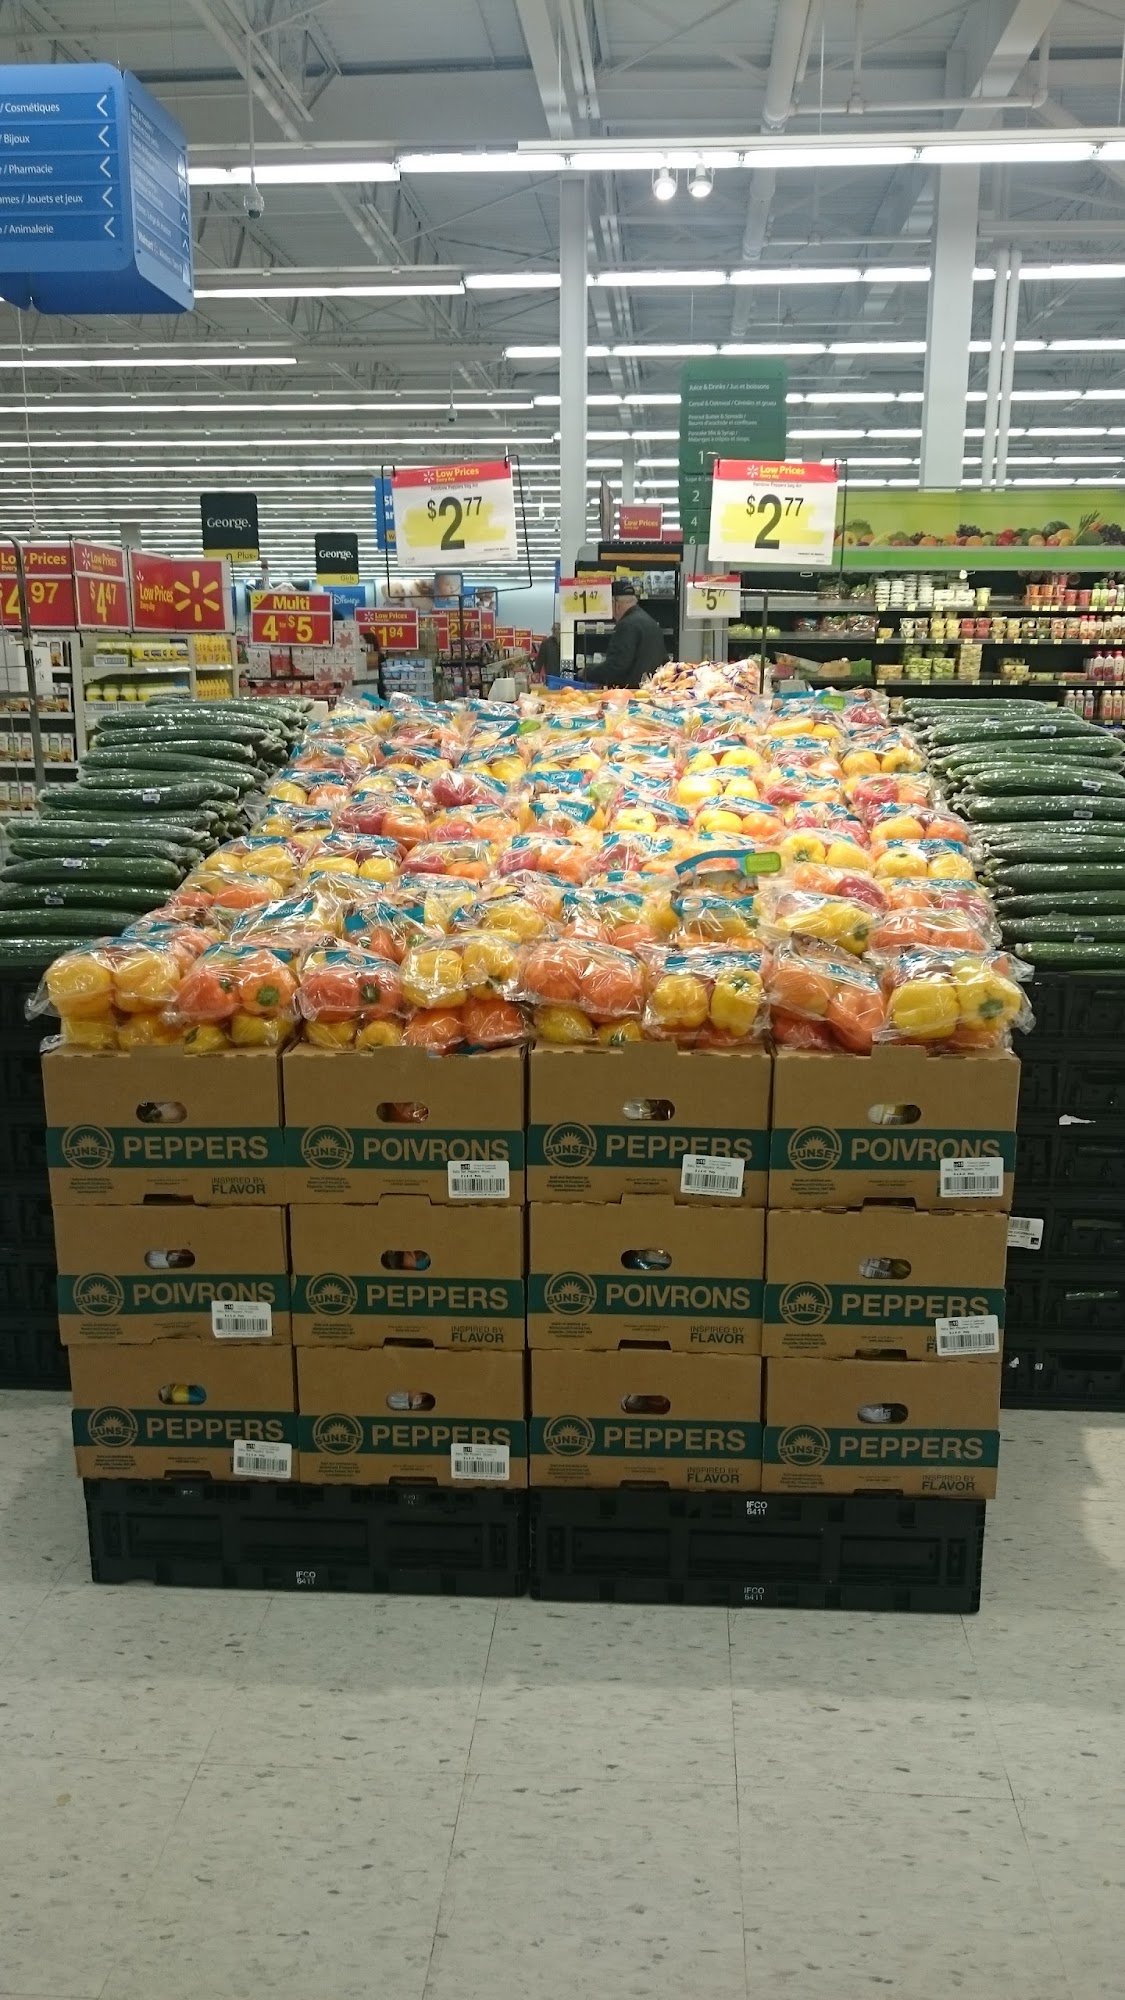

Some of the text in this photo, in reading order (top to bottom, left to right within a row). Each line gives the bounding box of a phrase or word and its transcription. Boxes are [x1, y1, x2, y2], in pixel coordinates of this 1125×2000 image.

[5, 102, 60, 114] Cosmétiques
[4, 133, 31, 146] Bijoux
[9, 164, 53, 174] Pharmacie
[27, 194, 53, 204] Jouets
[55, 195, 63, 203] et
[64, 194, 83, 205] jeux
[9, 224, 54, 234] Animalerie
[698, 450, 704, 465] 1
[436, 467, 480, 477] Low Prices
[760, 465, 805, 475] Low Prices
[692, 490, 700, 502] 2
[691, 516, 697, 526] 4
[689, 536, 695, 545] 6
[29, 553, 67, 565] Prices
[91, 551, 117, 567] Low Prices
[140, 583, 174, 603] Low Prices
[273, 595, 310, 610] Multi
[262, 615, 278, 641] 4
[65, 1146, 114, 1160] SUNSET
[122, 1135, 269, 1160] PEPPERS
[303, 1145, 353, 1159] SUNSET
[363, 1137, 510, 1162] POIVRONS
[545, 1144, 595, 1157] SUNSET
[605, 1134, 753, 1162] PEPPERS
[851, 1137, 1001, 1162] POIVRONS
[790, 1147, 839, 1162] SUNSET
[211, 1184, 266, 1195] FLAVOR
[132, 1281, 276, 1306] POIVRONS
[308, 1293, 357, 1306] SUNSET
[366, 1284, 509, 1311] PEPPERS
[547, 1293, 596, 1306] SUNSET
[605, 1283, 750, 1310] POIVRONS
[75, 1294, 123, 1307] SUNSET
[841, 1293, 989, 1318] PEPPERS
[781, 1302, 831, 1315] SUNSET
[451, 1326, 490, 1334] INSPIRED
[690, 1325, 744, 1334] INSPIRED BY
[451, 1332, 504, 1344] FLAVOR
[690, 1332, 744, 1344] FLAVOR
[90, 1426, 138, 1439] SUNSET
[146, 1417, 284, 1441] PEPPERS
[371, 1424, 511, 1447] PEPPERS
[315, 1433, 363, 1445] SUNSET
[546, 1436, 595, 1448] SUNSET
[603, 1426, 746, 1451] PEPPERS
[780, 1446, 829, 1458] SUNSET
[839, 1436, 983, 1460] PEPPERS
[687, 1466, 726, 1474] INSPIRED
[687, 1473, 740, 1484] FLAVOR
[922, 1474, 962, 1482] INSPIRED
[922, 1481, 976, 1492] FLAVOR
[746, 1500, 768, 1508] IFCO
[296, 1570, 316, 1578] IFCO
